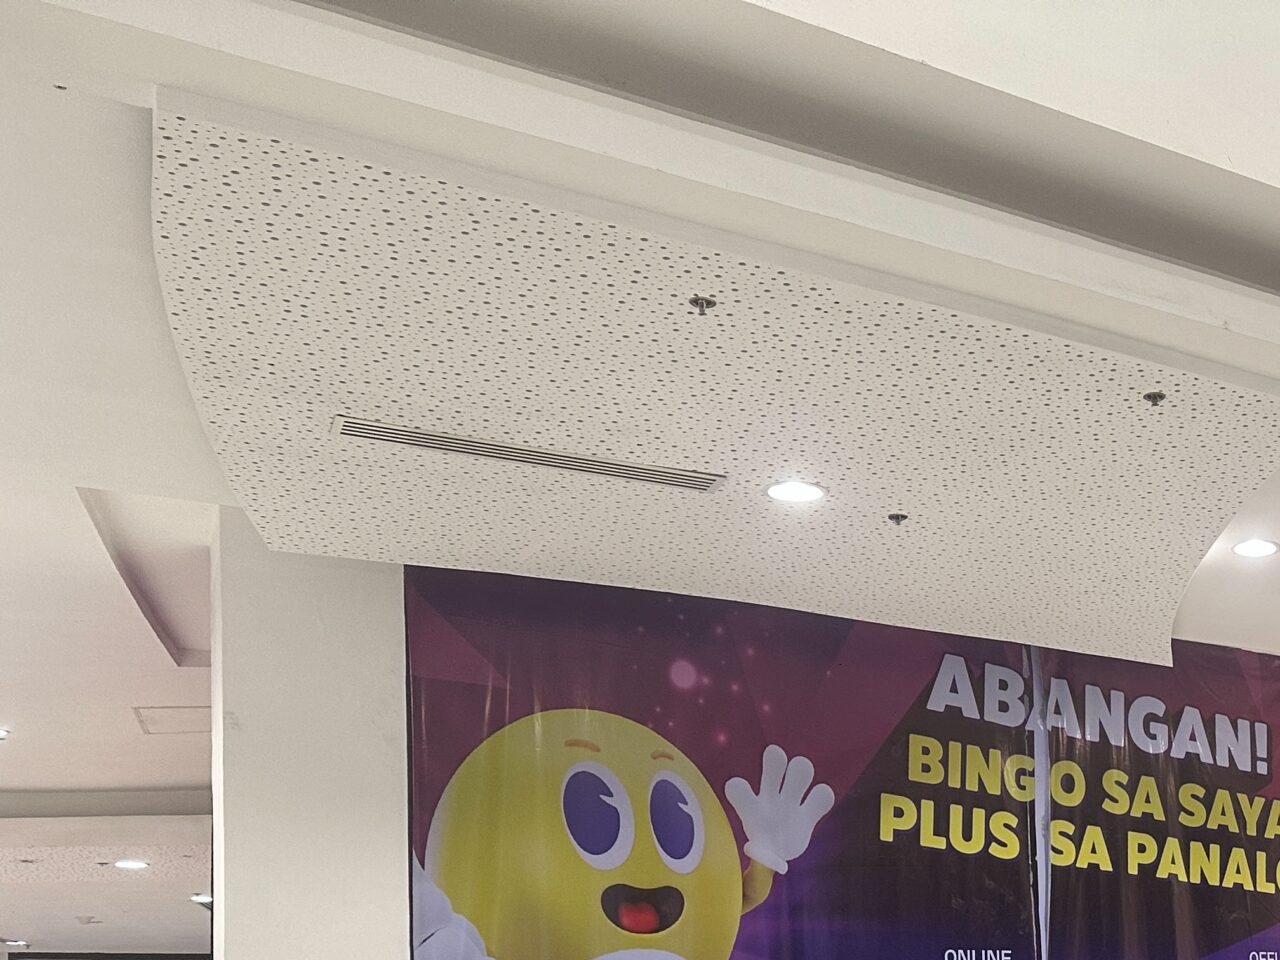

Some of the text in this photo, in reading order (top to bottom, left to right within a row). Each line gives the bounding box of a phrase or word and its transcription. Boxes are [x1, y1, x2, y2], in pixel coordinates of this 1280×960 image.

[926, 653, 1268, 775] ABANGAN!
[908, 733, 1087, 808] BINGO
[1102, 768, 1166, 821] SA
[880, 793, 1021, 860] PLUS
[1049, 819, 1113, 872] SA
